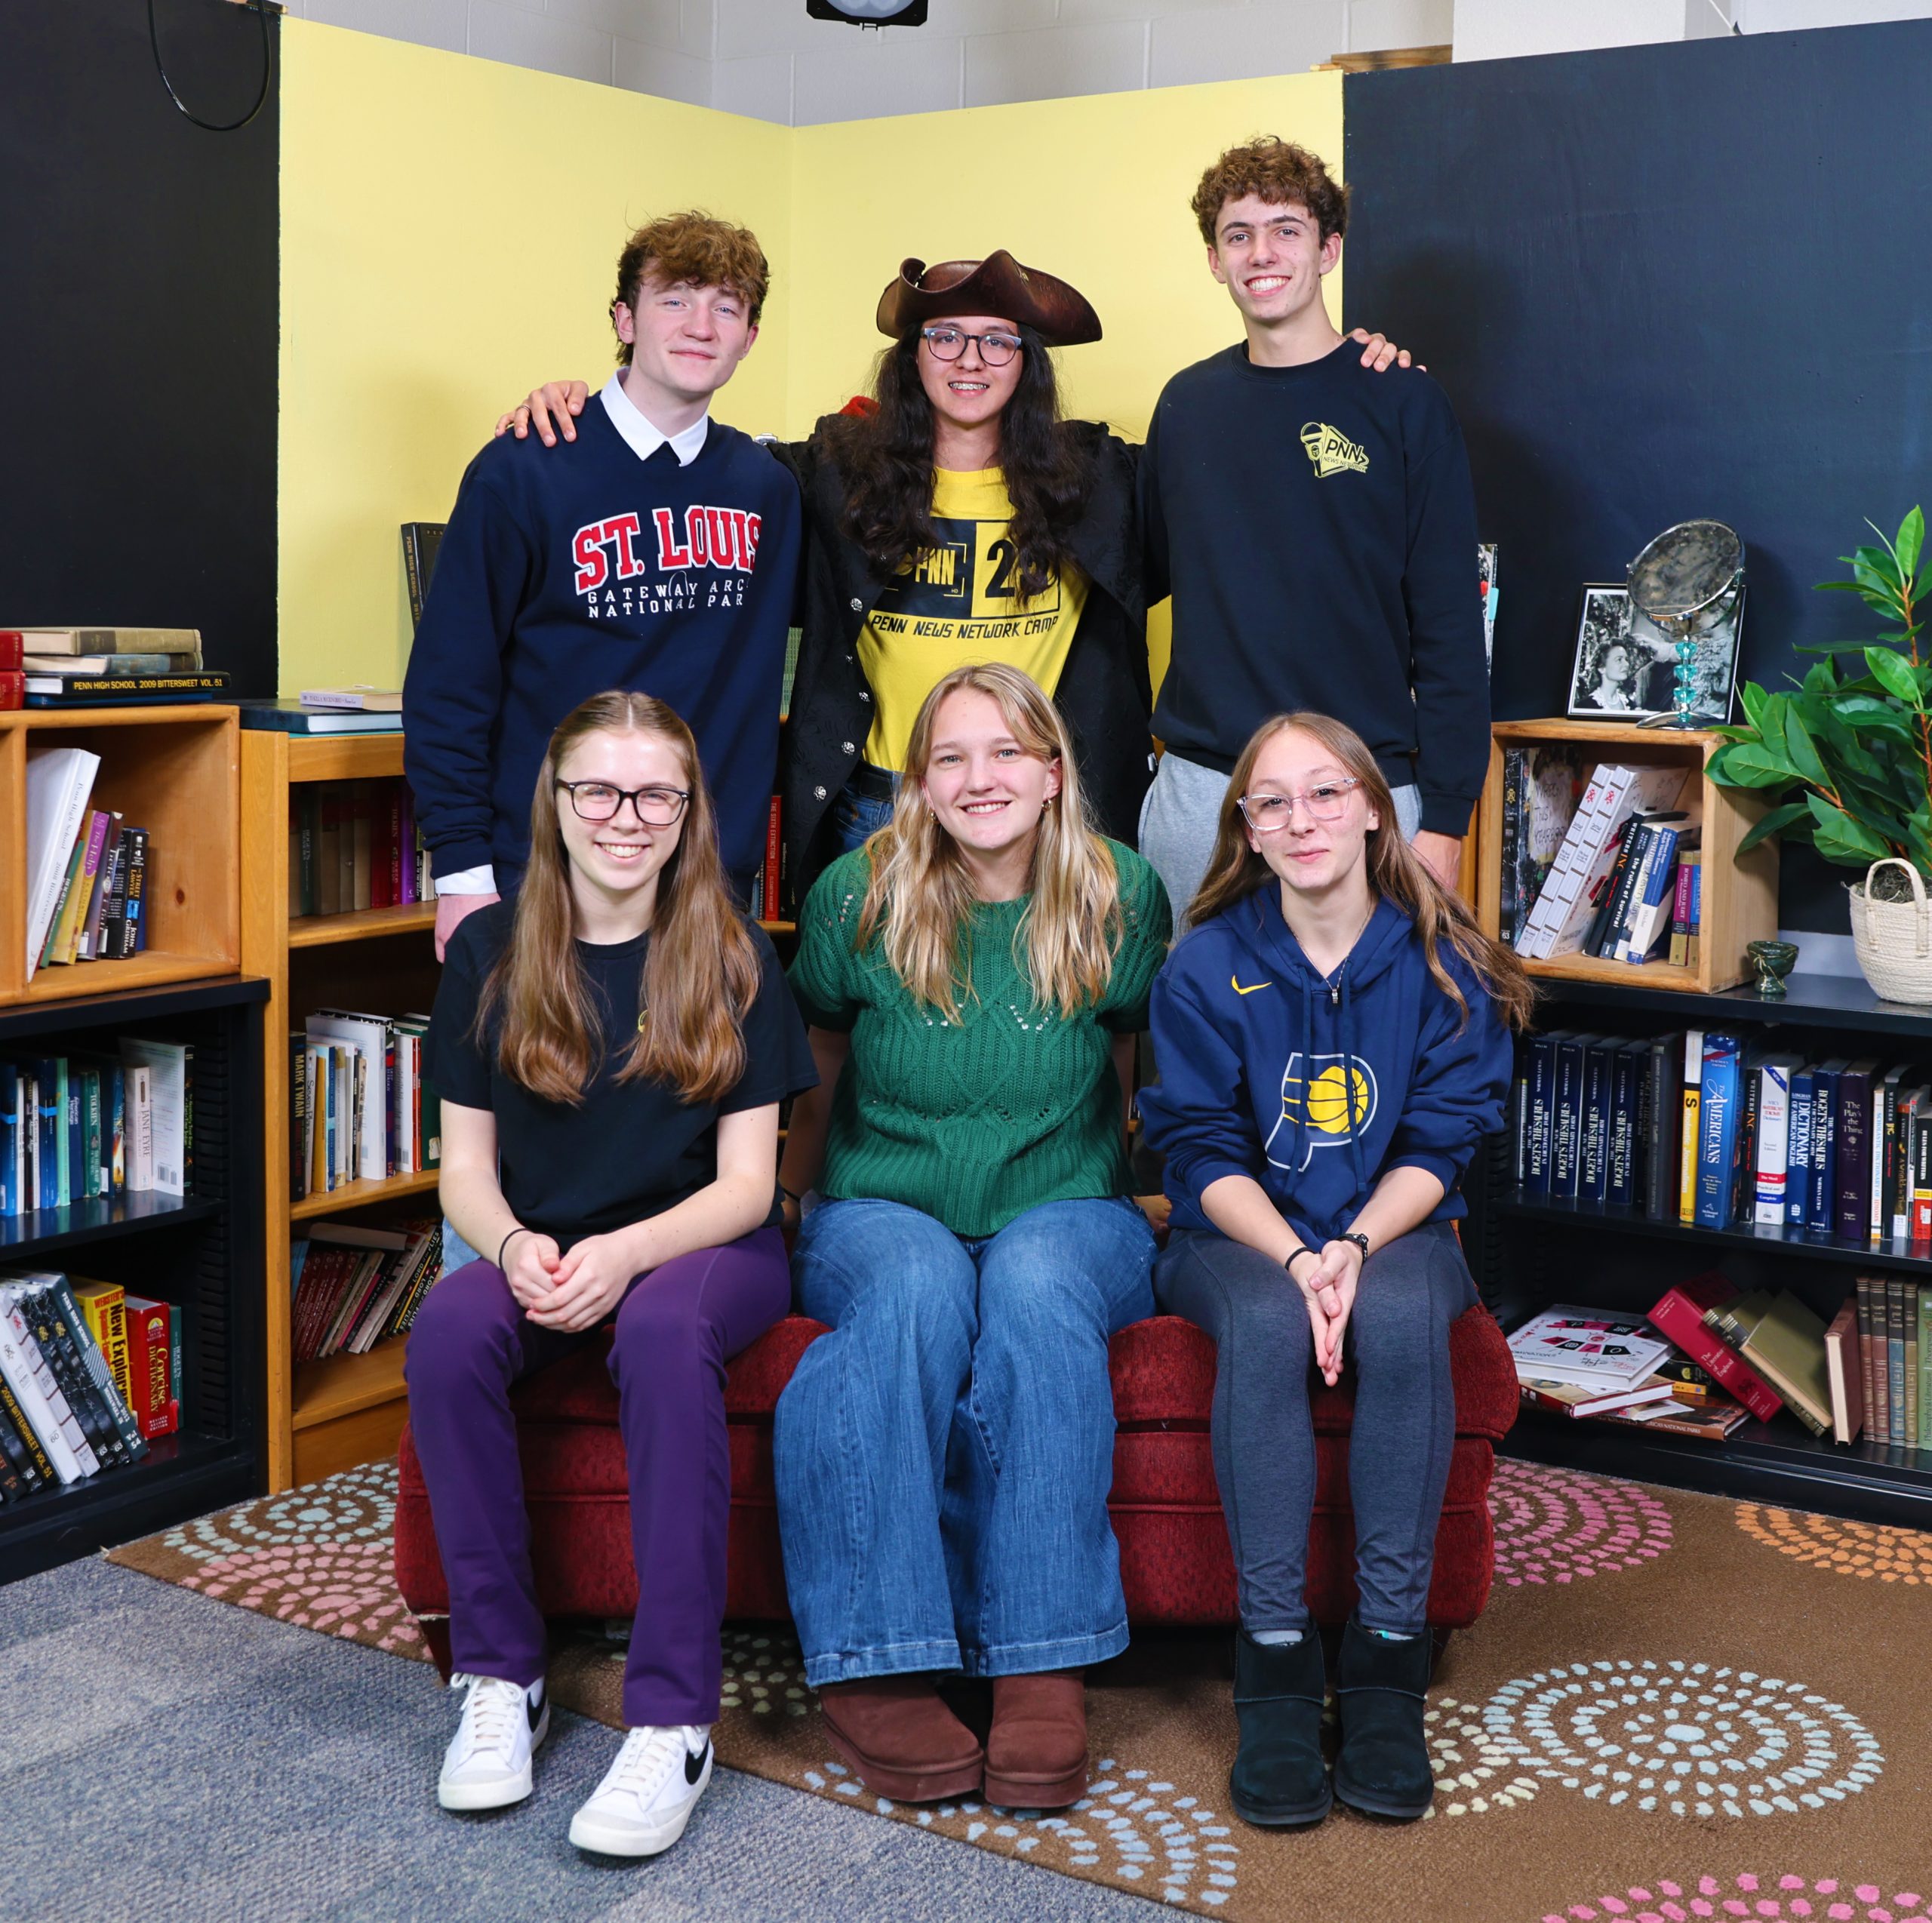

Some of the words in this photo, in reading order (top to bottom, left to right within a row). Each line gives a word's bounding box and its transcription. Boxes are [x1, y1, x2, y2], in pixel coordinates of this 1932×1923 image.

[1325, 438, 1363, 461] PNN
[572, 512, 645, 595] ST.
[652, 505, 761, 575] LOUIS
[588, 583, 697, 603] GATEWAY
[709, 578, 749, 592] ARC
[589, 598, 694, 618] NATIONAL
[870, 614, 908, 633] PENN
[913, 620, 954, 638] NEWS
[956, 622, 1020, 638] NETWORK
[1024, 616, 1058, 635] CAMP
[73, 682, 92, 690] PENN
[94, 681, 110, 689] HIGH
[111, 680, 137, 689] SCHOOL
[140, 680, 156, 688] 2009
[158, 679, 198, 688] BITTERSWEET
[1623, 823, 1638, 854] WRITERS
[86, 845, 98, 869] Help
[1631, 857, 1639, 869] the
[134, 874, 143, 898] STREET
[1623, 890, 1629, 899] of
[1625, 871, 1635, 889] rules
[1613, 900, 1626, 928] survival
[123, 919, 132, 953] GRISHAM
[295, 1054, 304, 1083] MARK
[295, 1087, 304, 1117] TWAIN
[1817, 1090, 1829, 1123] ROGET'S
[141, 1110, 150, 1132] JANE
[1533, 1099, 1544, 1141] THESAURUS
[1559, 1103, 1571, 1145] THESAURUS
[1587, 1106, 1599, 1149] THESAURUS
[1614, 1110, 1627, 1153] THESAURUS
[1684, 1097, 1697, 1144] Scholastic
[1705, 1079, 1728, 1164] AMERICANS
[1796, 1102, 1811, 1168] DICTIONARY
[1531, 1143, 1542, 1175] ROGET'S
[1558, 1147, 1568, 1179] ROGET'S
[1814, 1125, 1827, 1170] THESAURUS
[1586, 1150, 1596, 1183] ROGET'S
[1613, 1155, 1624, 1187] ROGET'S
[1681, 1146, 1690, 1192] Journalism
[414, 1278, 426, 1297] LORD
[62, 1291, 72, 1311] PENN
[71, 1310, 80, 1326] HIGH
[78, 1325, 91, 1348] SCHOOL
[110, 1304, 124, 1337] New
[1701, 1352, 1712, 1361] The
[1716, 1358, 1734, 1377] England
[149, 1346, 158, 1413] DICTIONARY
[156, 1348, 168, 1405] Concise
[2, 1389, 13, 1407] 2009
[11, 1403, 38, 1451] BITTERSWEET
[44, 1465, 53, 1477] 51
[131, 1439, 142, 1449] 54
